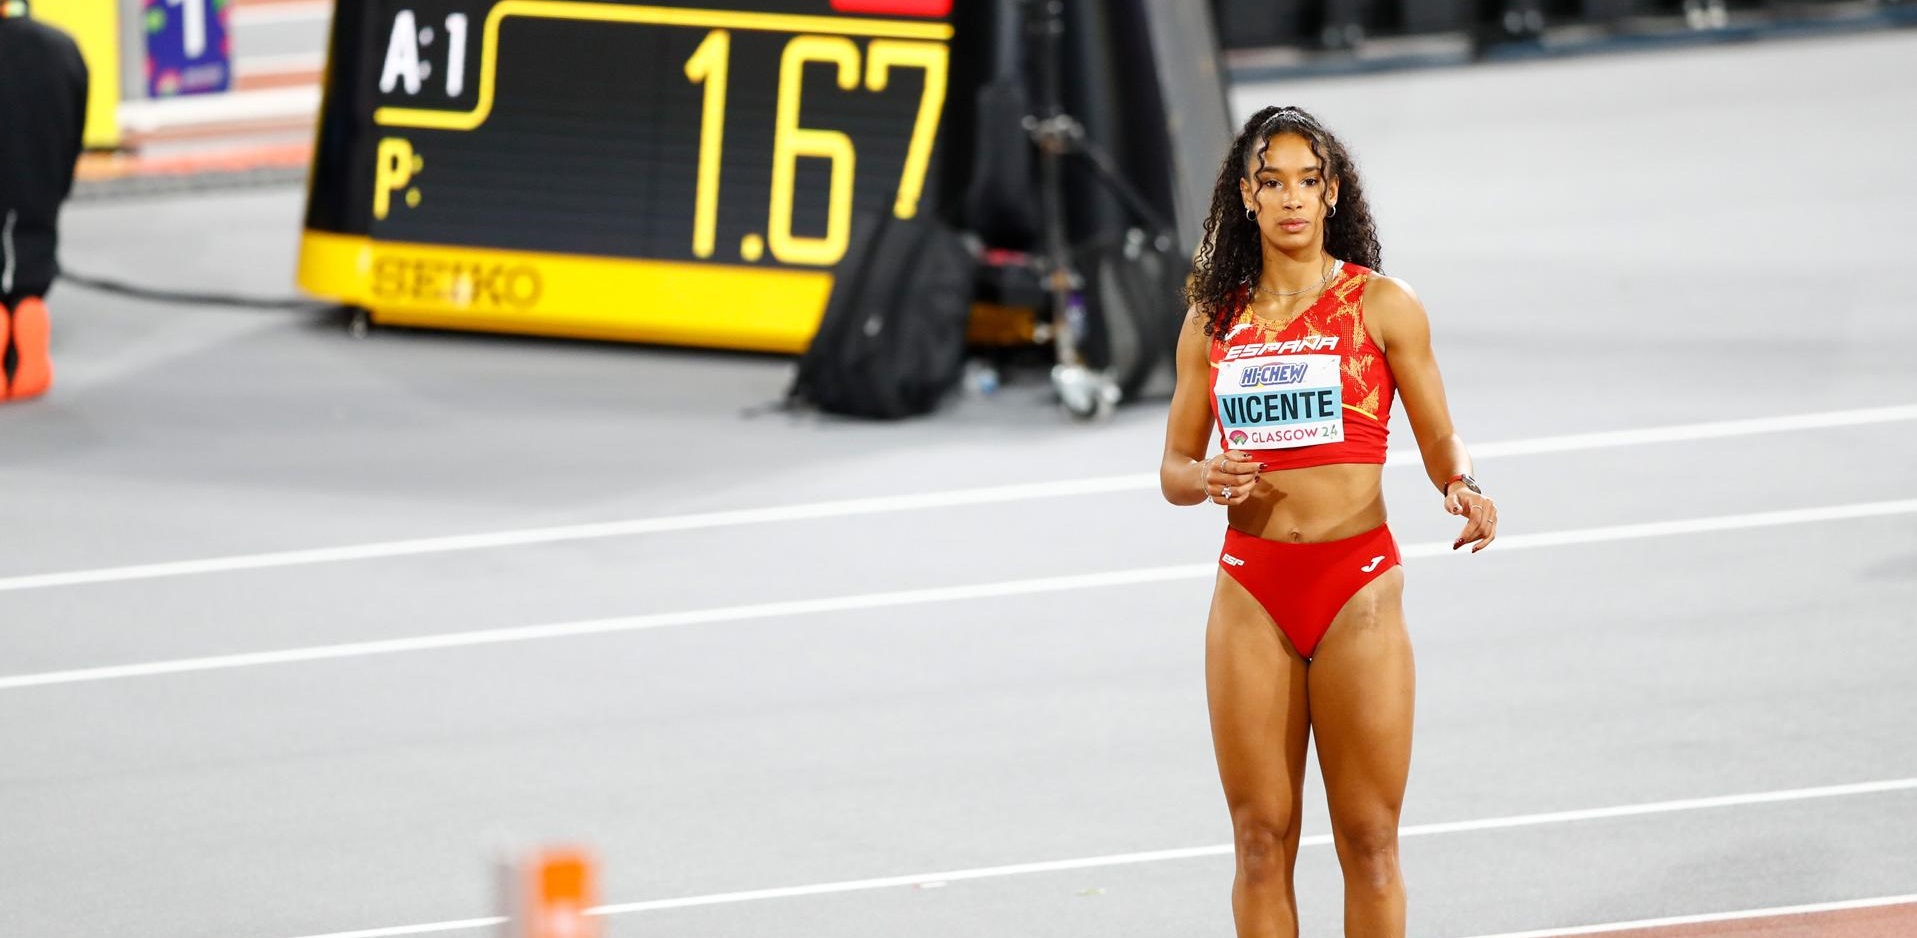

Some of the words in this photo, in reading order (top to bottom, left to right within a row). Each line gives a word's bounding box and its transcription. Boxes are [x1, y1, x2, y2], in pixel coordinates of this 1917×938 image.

[684, 29, 950, 266] 1.67
[371, 256, 544, 310] SEIKO
[1240, 362, 1308, 387] HI-CHEW
[1222, 390, 1334, 424] VICENTE
[1252, 428, 1318, 443] GLASGOW
